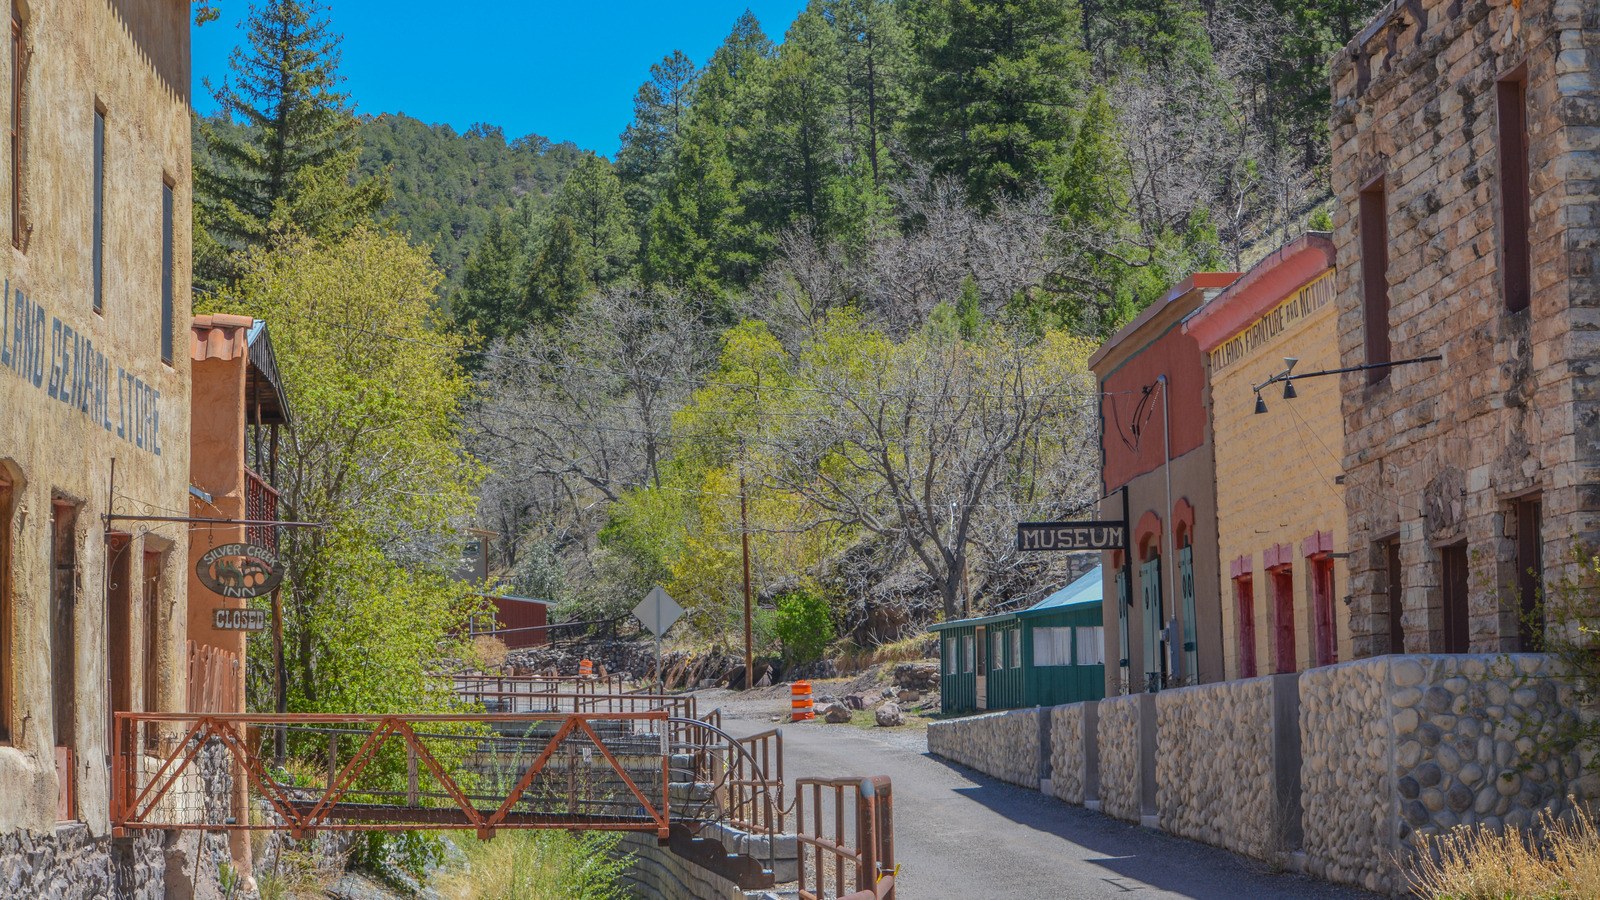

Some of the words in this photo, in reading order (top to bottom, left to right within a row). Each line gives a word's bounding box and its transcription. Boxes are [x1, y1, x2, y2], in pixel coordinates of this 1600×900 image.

[1299, 271, 1336, 318] NOTIONS
[117, 366, 160, 455] STORE
[1023, 527, 1122, 549] MUSEUM
[203, 544, 241, 565] SILVER
[246, 545, 278, 567] CREEK
[223, 586, 256, 597] INN
[216, 610, 264, 630] CLOSED
